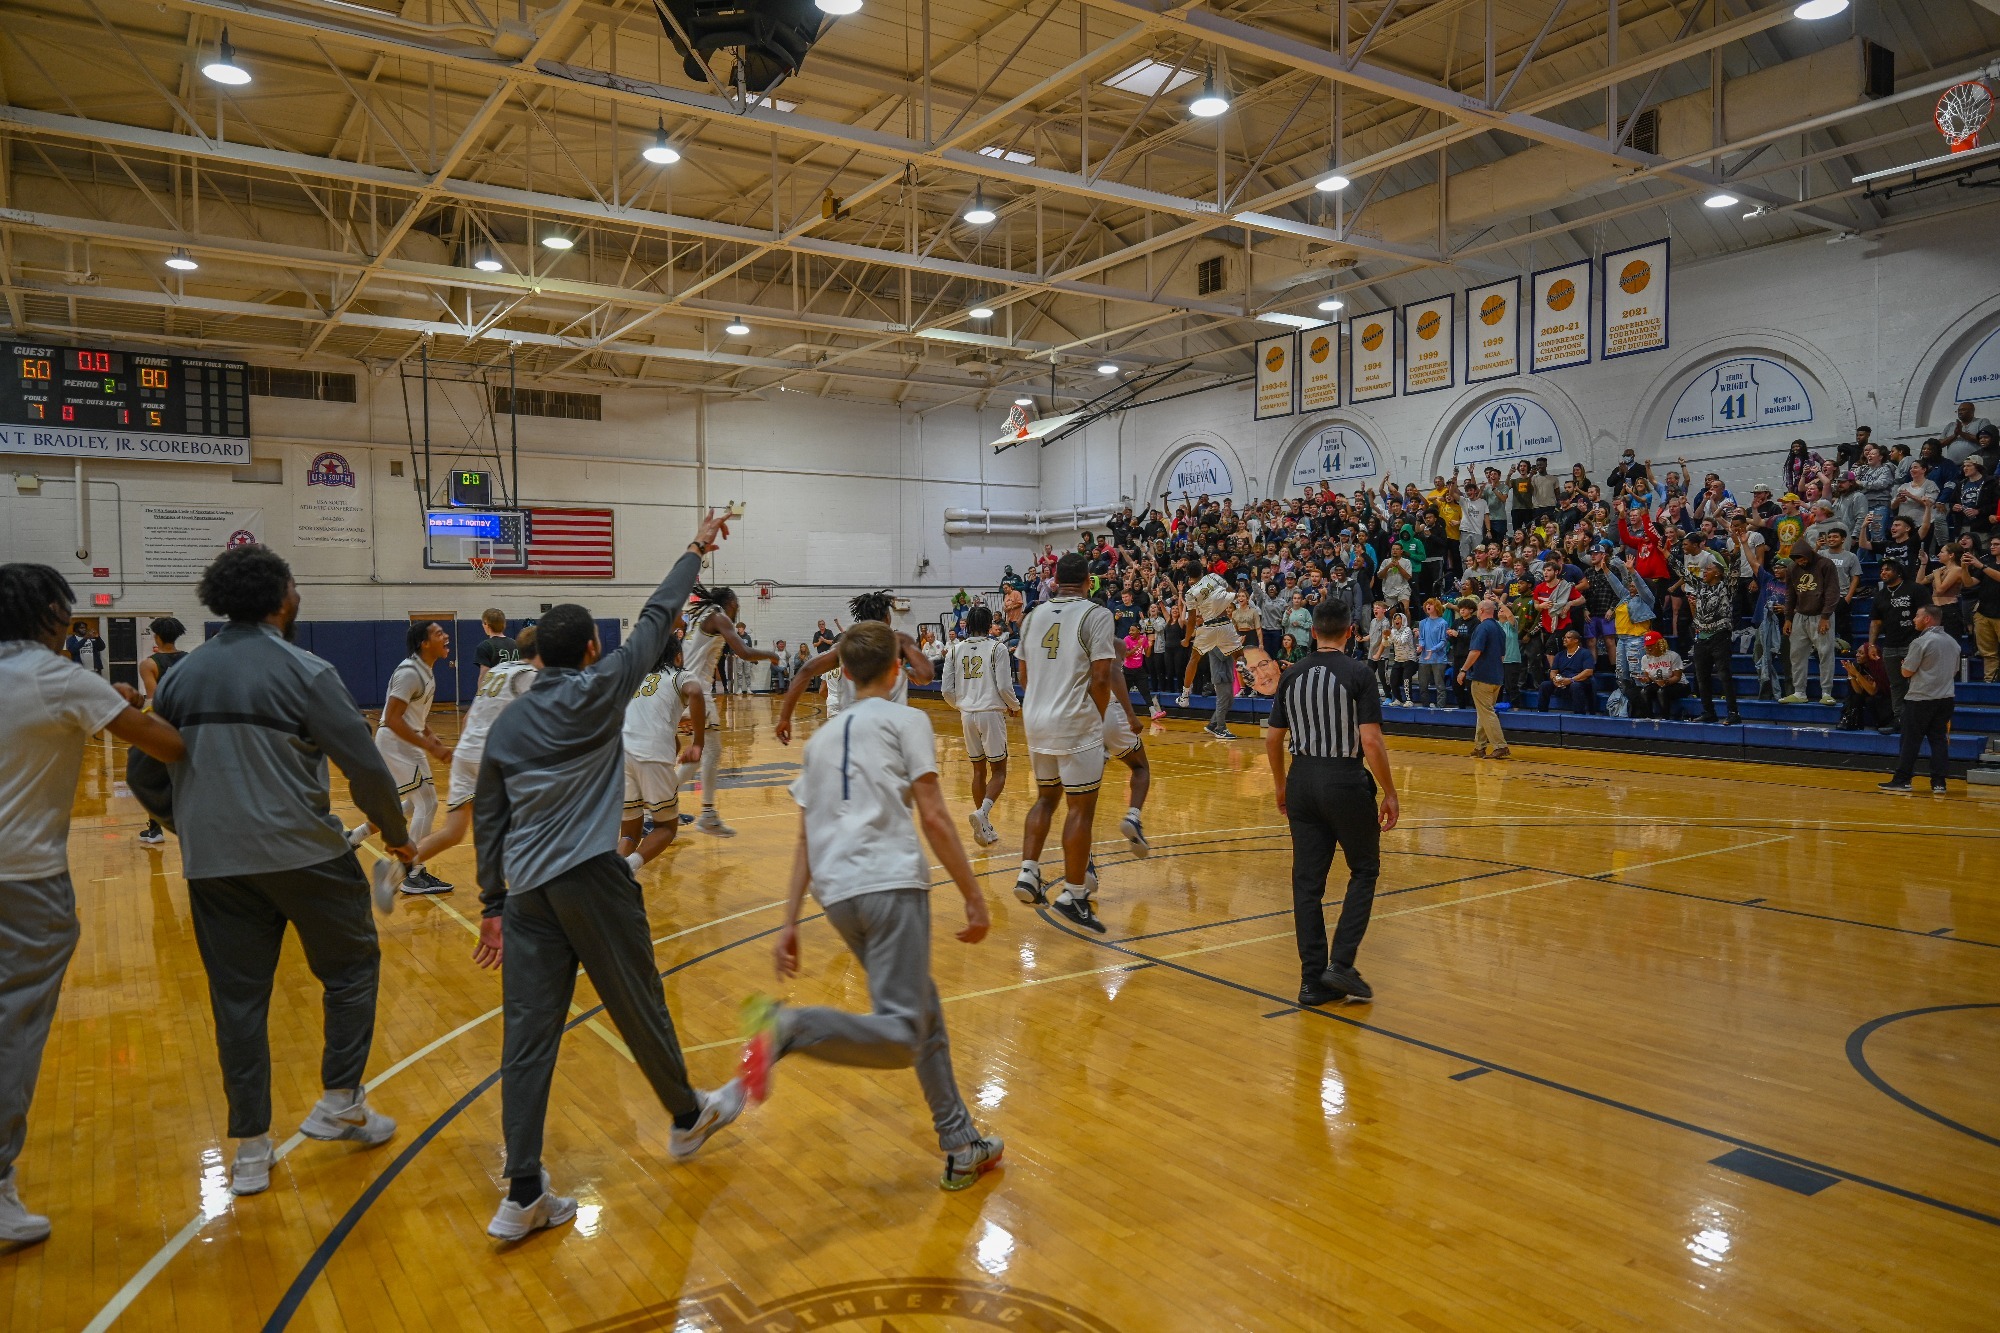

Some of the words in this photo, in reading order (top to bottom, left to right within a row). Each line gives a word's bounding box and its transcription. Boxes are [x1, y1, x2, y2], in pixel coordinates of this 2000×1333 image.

[1622, 307, 1648, 319] 2021
[1541, 322, 1580, 336] 2020-21
[1609, 324, 1662, 339] TOURNAMENT
[1610, 318, 1660, 332] CONFERENCE
[1483, 337, 1504, 348] 1999
[1538, 334, 1584, 347] CONFERENCE
[1612, 332, 1658, 345] CHAMPIONS
[14, 347, 53, 357] GUEST
[1540, 342, 1582, 354] CHAMPIONS
[1608, 345, 1626, 354] EAST
[1628, 338, 1663, 349] DIVISION
[78, 351, 110, 372] 0.0
[135, 357, 168, 367] HOME
[1419, 351, 1438, 361] 1999
[1536, 355, 1553, 364] EAST
[1555, 349, 1586, 360] DIVISION
[23, 359, 50, 380] 60
[1364, 362, 1381, 371] 1994
[1471, 359, 1514, 371] TOURNAMENT
[64, 379, 98, 389] PERIOD
[141, 368, 168, 389] 80
[1312, 374, 1328, 382] 1994
[1970, 373, 2000, 383] 1998-20
[104, 379, 115, 393] 2
[1720, 381, 1748, 392] WRIGHT
[1720, 393, 1746, 419] 41
[1773, 396, 1792, 404] Men's
[33, 404, 44, 419] 7
[1764, 403, 1800, 414] Basketball
[123, 410, 129, 424] 1
[151, 412, 161, 426] 5
[14, 432, 25, 445] T.
[34, 434, 109, 450] BRADLEY,
[116, 438, 134, 451] JR.
[141, 439, 243, 456] SCOREBOARD
[1497, 429, 1514, 451] 11
[1524, 436, 1552, 445] Volleyball
[1323, 453, 1341, 472] 44
[312, 473, 327, 481] USA
[328, 474, 350, 482] SOUTH
[1178, 468, 1216, 488] WESLEYAN
[1041, 623, 1061, 659] 4
[962, 656, 983, 679] 12
[476, 672, 508, 698] 20
[763, 1294, 953, 1333] ATHLETIC
